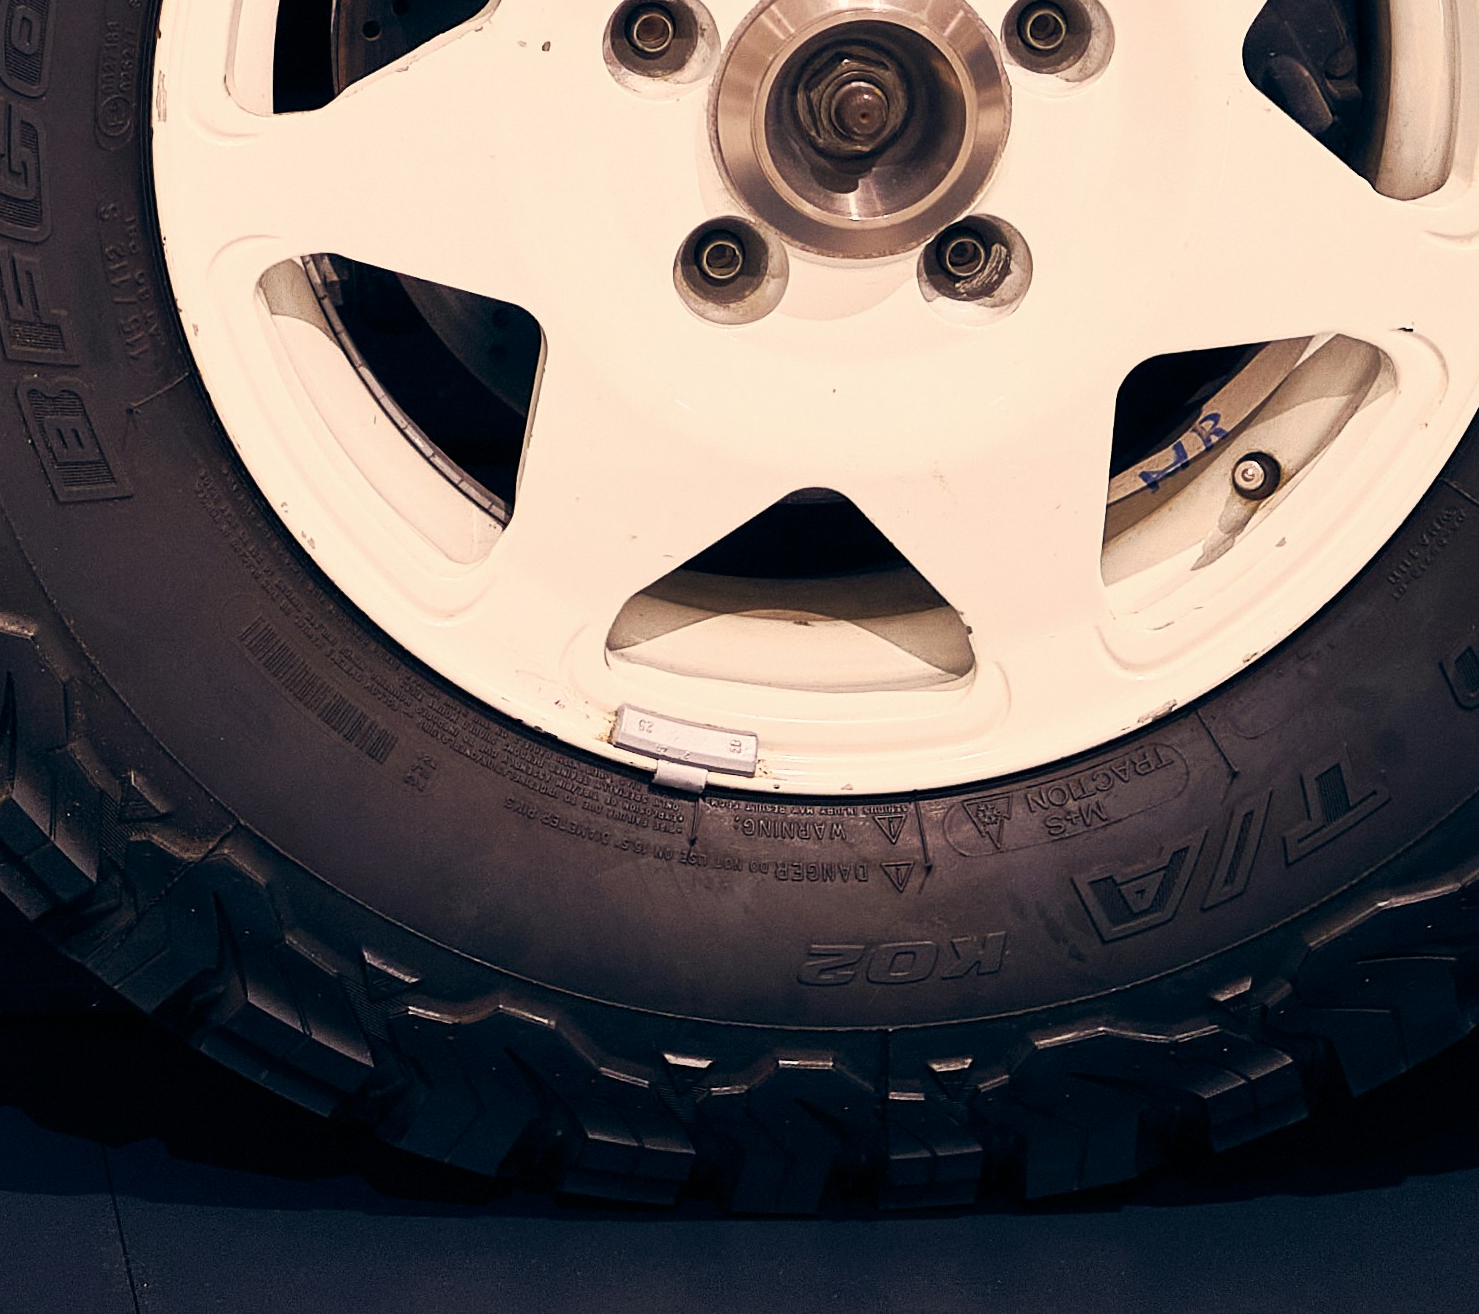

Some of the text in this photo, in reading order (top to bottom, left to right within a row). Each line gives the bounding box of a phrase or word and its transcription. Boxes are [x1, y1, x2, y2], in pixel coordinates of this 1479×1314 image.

[1027, 745, 1172, 812] TRACTION
[1043, 799, 1107, 838] M+S
[711, 854, 744, 874] NOT
[746, 857, 770, 875] DO
[772, 857, 868, 884] DANGER
[806, 761, 1393, 986] T/A KO2
